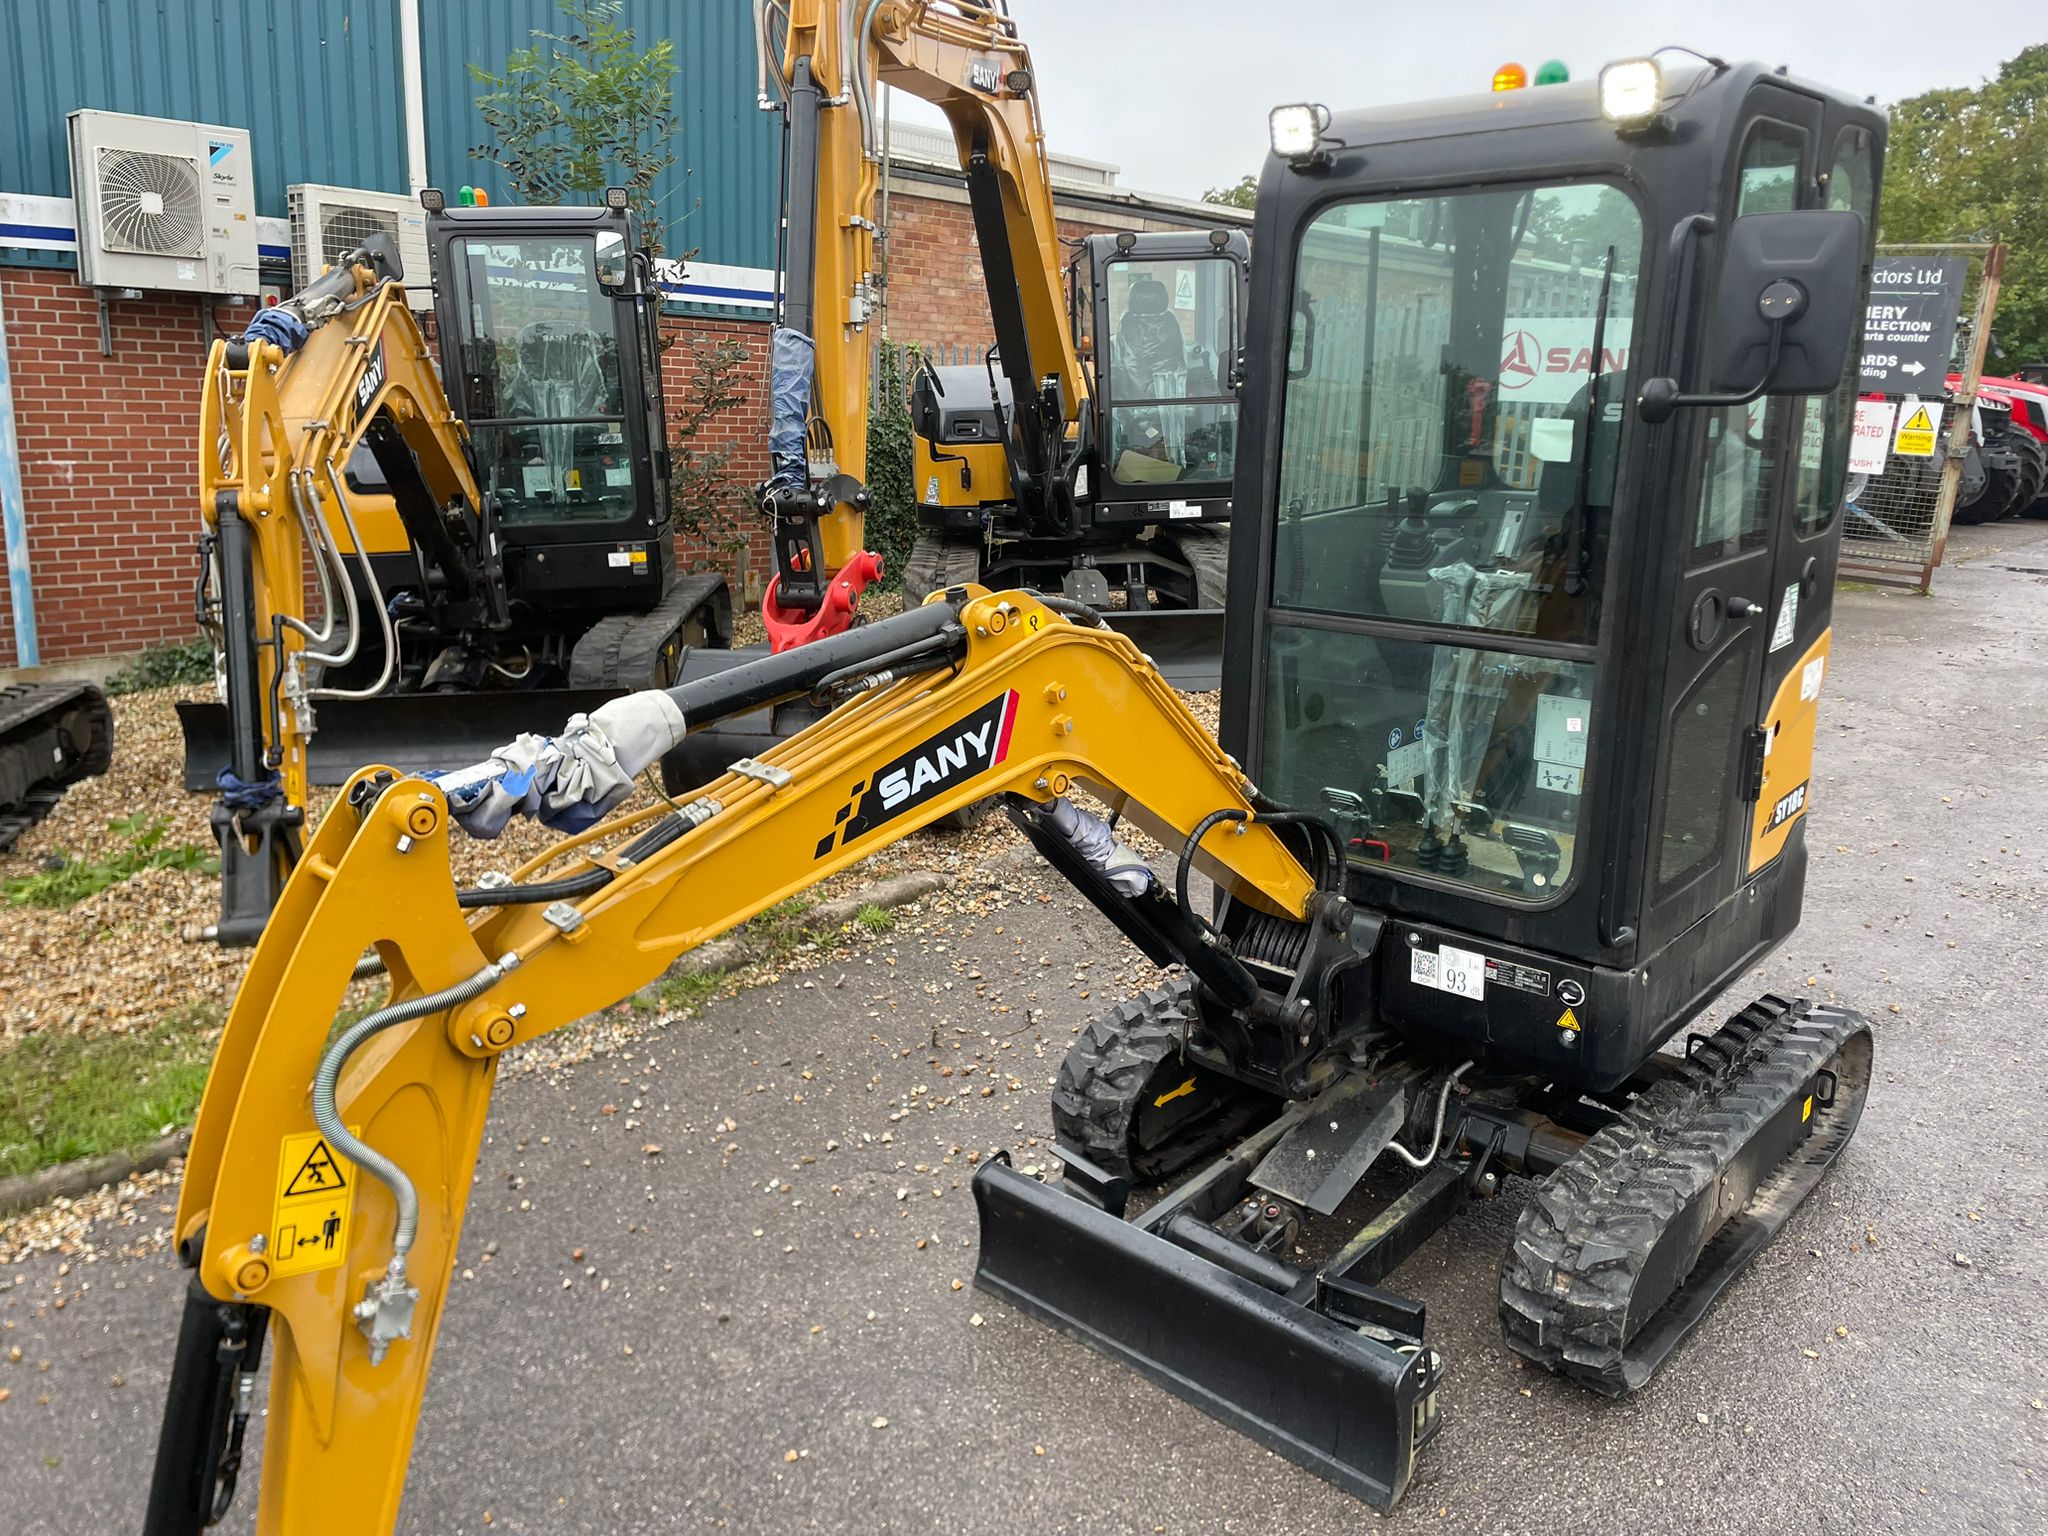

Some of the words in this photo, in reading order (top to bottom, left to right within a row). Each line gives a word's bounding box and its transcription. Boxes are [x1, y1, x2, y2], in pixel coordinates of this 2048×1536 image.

[973, 63, 997, 90] SANY
[1873, 269, 1912, 284] ctors
[1917, 268, 1943, 284] Ltd
[1886, 333, 1930, 343] counter
[1545, 347, 1630, 374] SAN
[358, 355, 382, 407] SANY
[1901, 433, 1933, 442] Warning
[878, 719, 992, 811] SANY
[1446, 968, 1467, 993] 93
